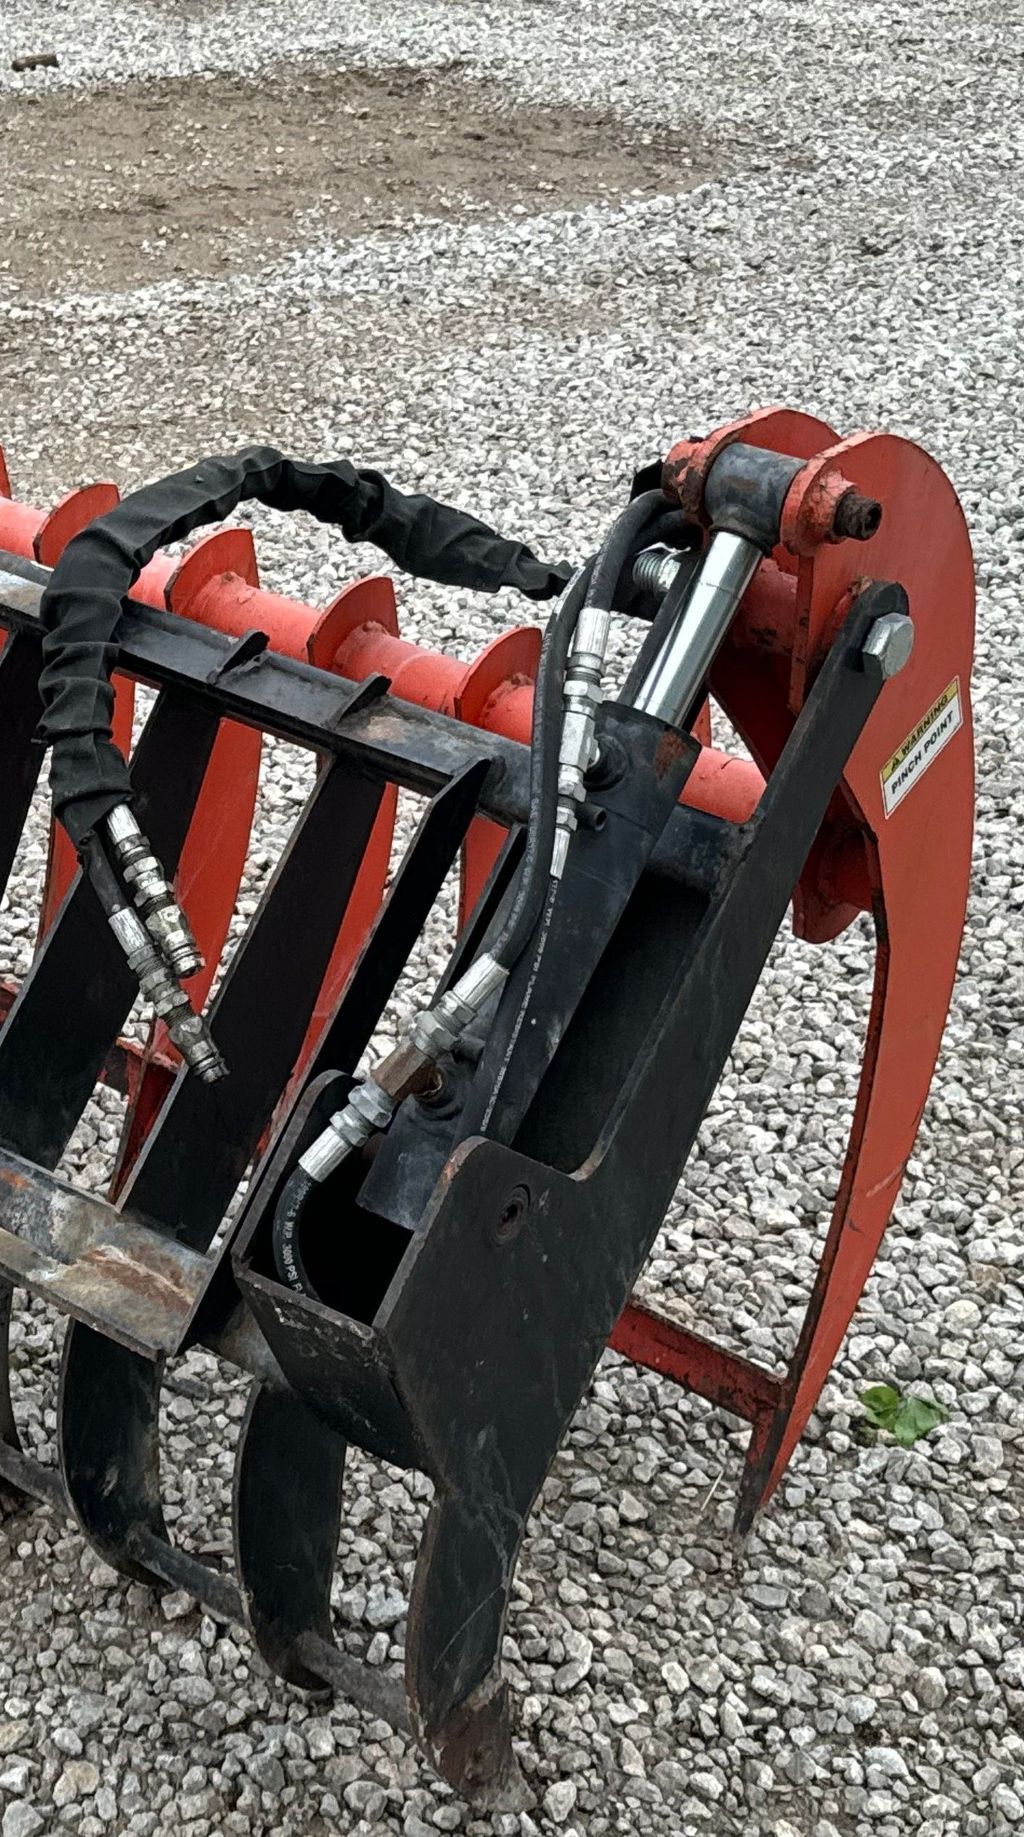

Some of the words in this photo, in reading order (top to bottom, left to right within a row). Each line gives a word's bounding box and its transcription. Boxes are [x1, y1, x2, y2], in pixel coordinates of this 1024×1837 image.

[891, 750, 923, 795] PINCH
[923, 709, 954, 754] POINT
[901, 694, 949, 756] WARNING
